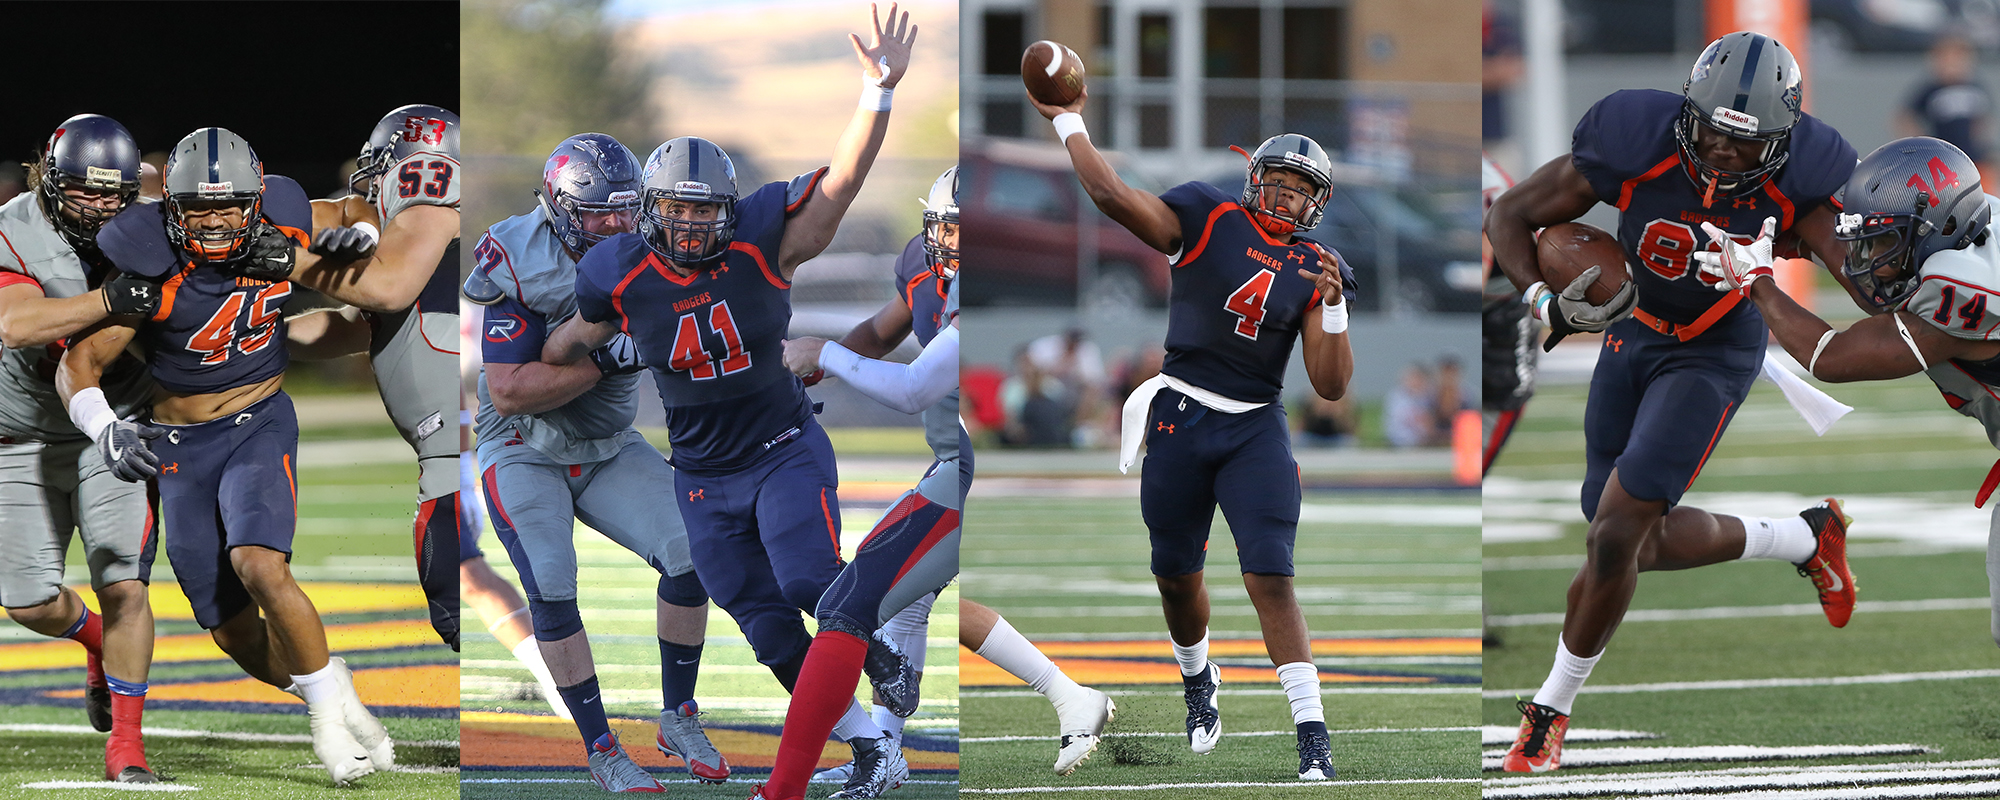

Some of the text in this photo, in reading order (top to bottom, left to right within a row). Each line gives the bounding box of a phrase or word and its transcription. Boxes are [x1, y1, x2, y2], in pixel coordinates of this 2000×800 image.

[403, 116, 446, 146] 53
[1723, 111, 1749, 123] Riddell
[398, 160, 454, 199] 53
[682, 182, 703, 190] Riddell
[1906, 156, 1961, 208] 14
[1245, 246, 1284, 272] BADGERS
[671, 291, 713, 313] BADGERS
[1223, 268, 1276, 341] 4
[1932, 284, 1987, 331] 14
[184, 280, 292, 365] 45
[668, 299, 752, 381] 41
